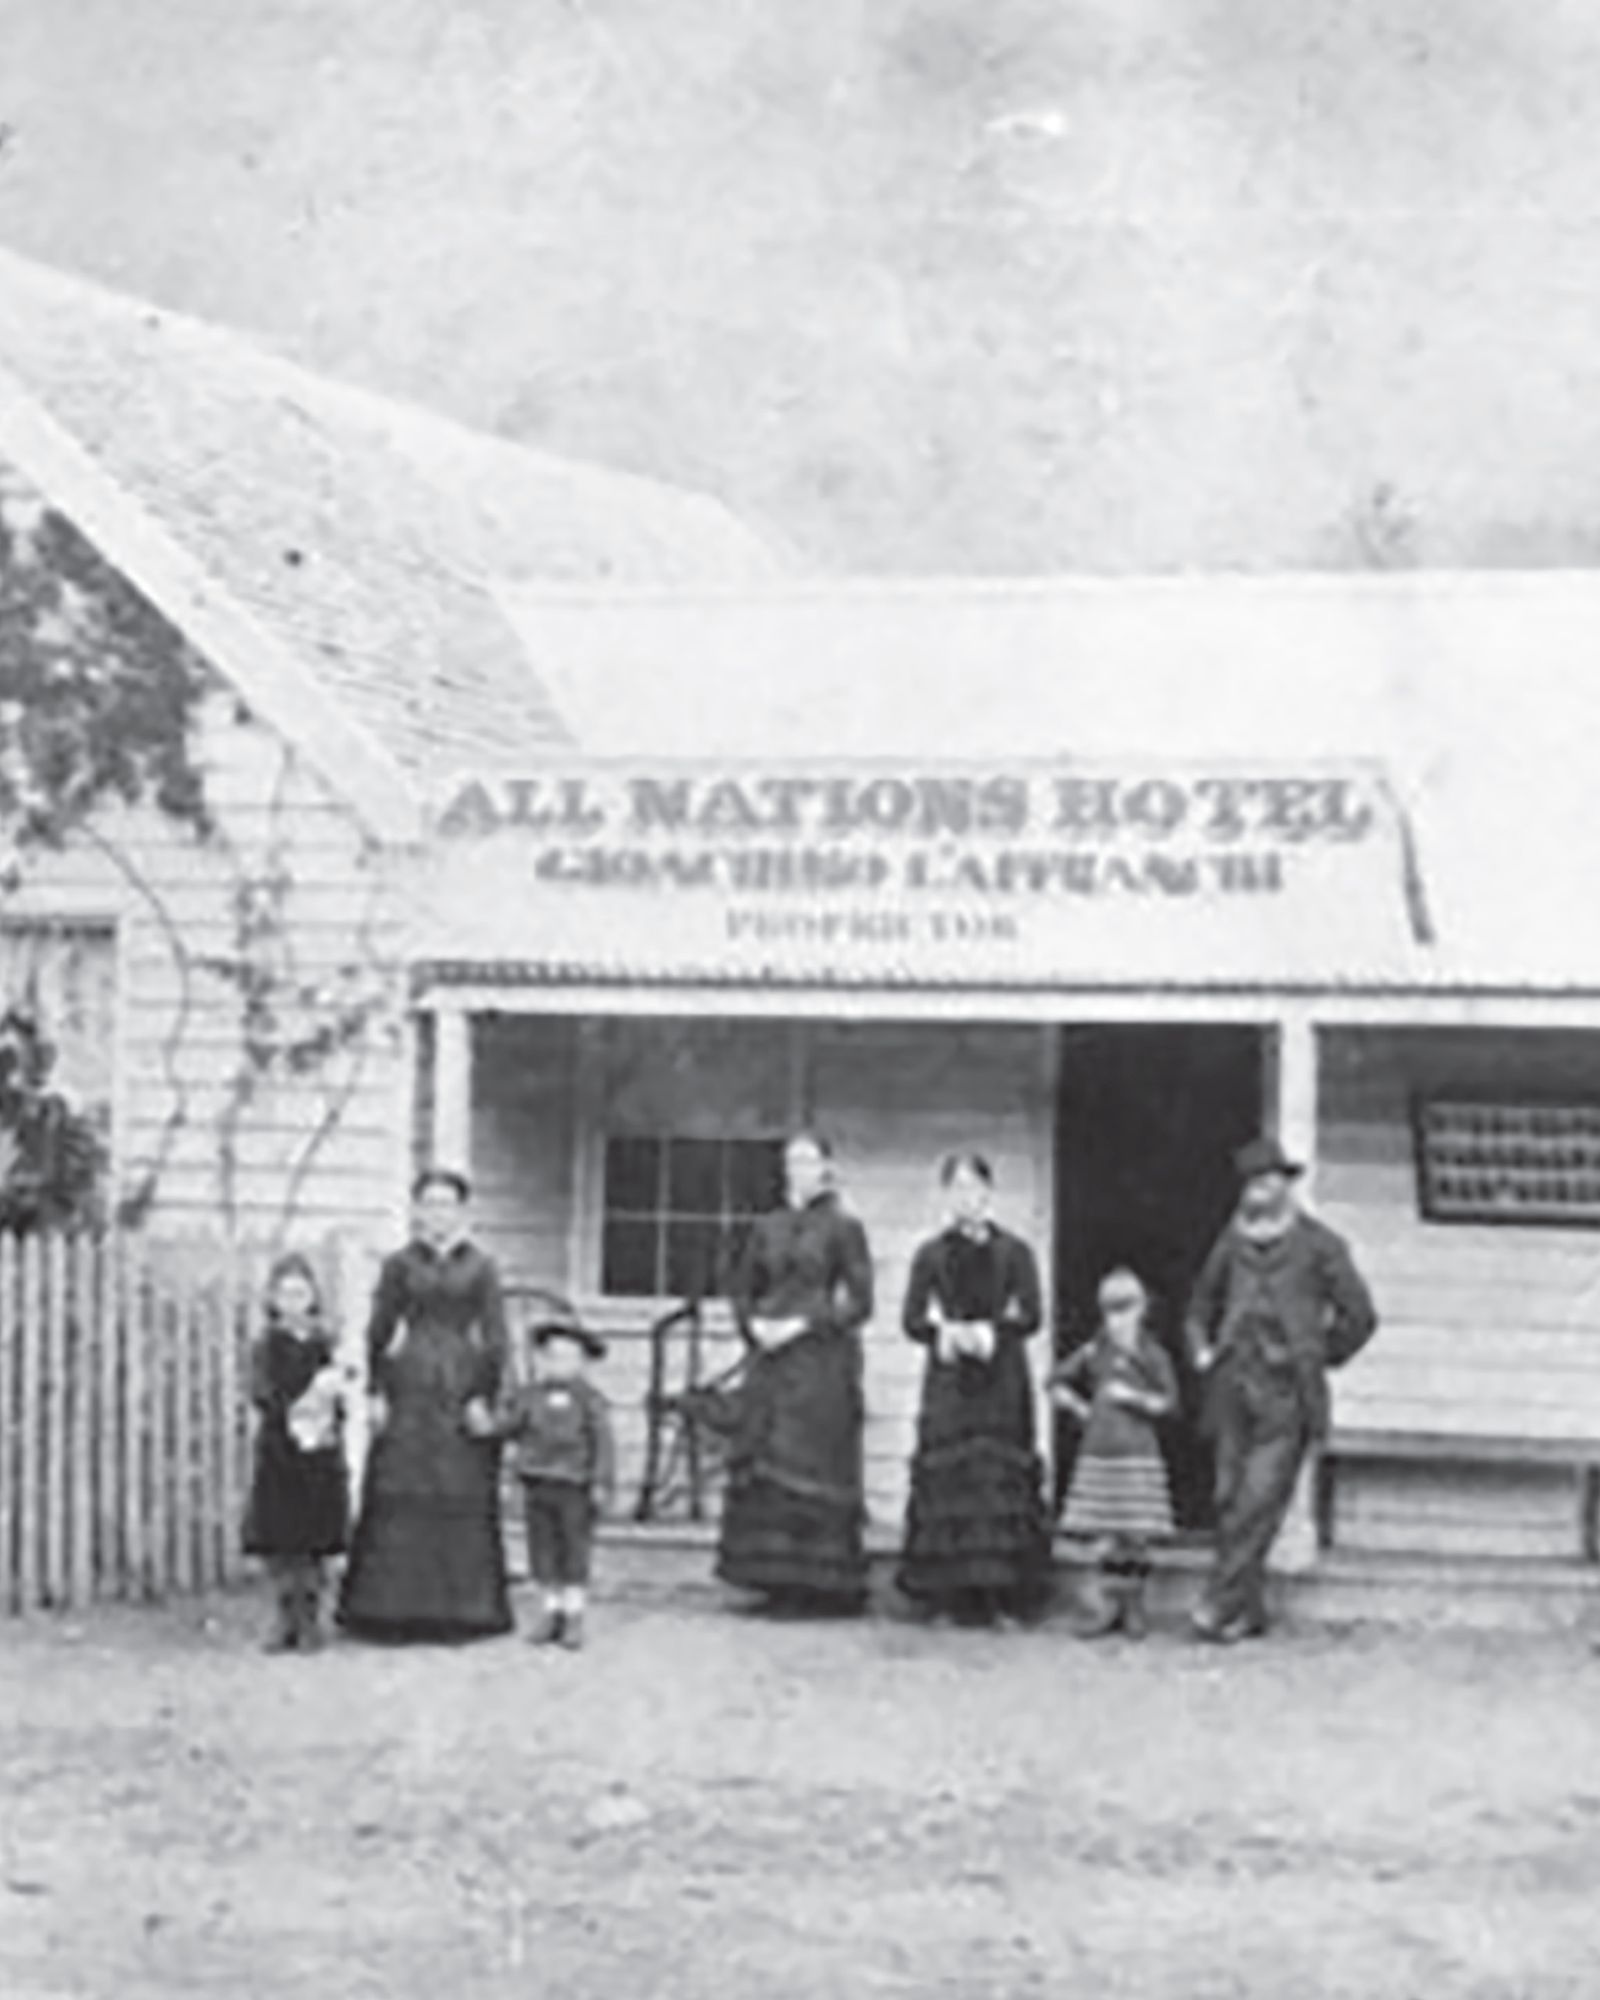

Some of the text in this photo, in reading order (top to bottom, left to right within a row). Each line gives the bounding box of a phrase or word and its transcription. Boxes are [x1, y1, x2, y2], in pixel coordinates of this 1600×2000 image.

[436, 777, 1374, 843] ALL NATIONS HOTEL
